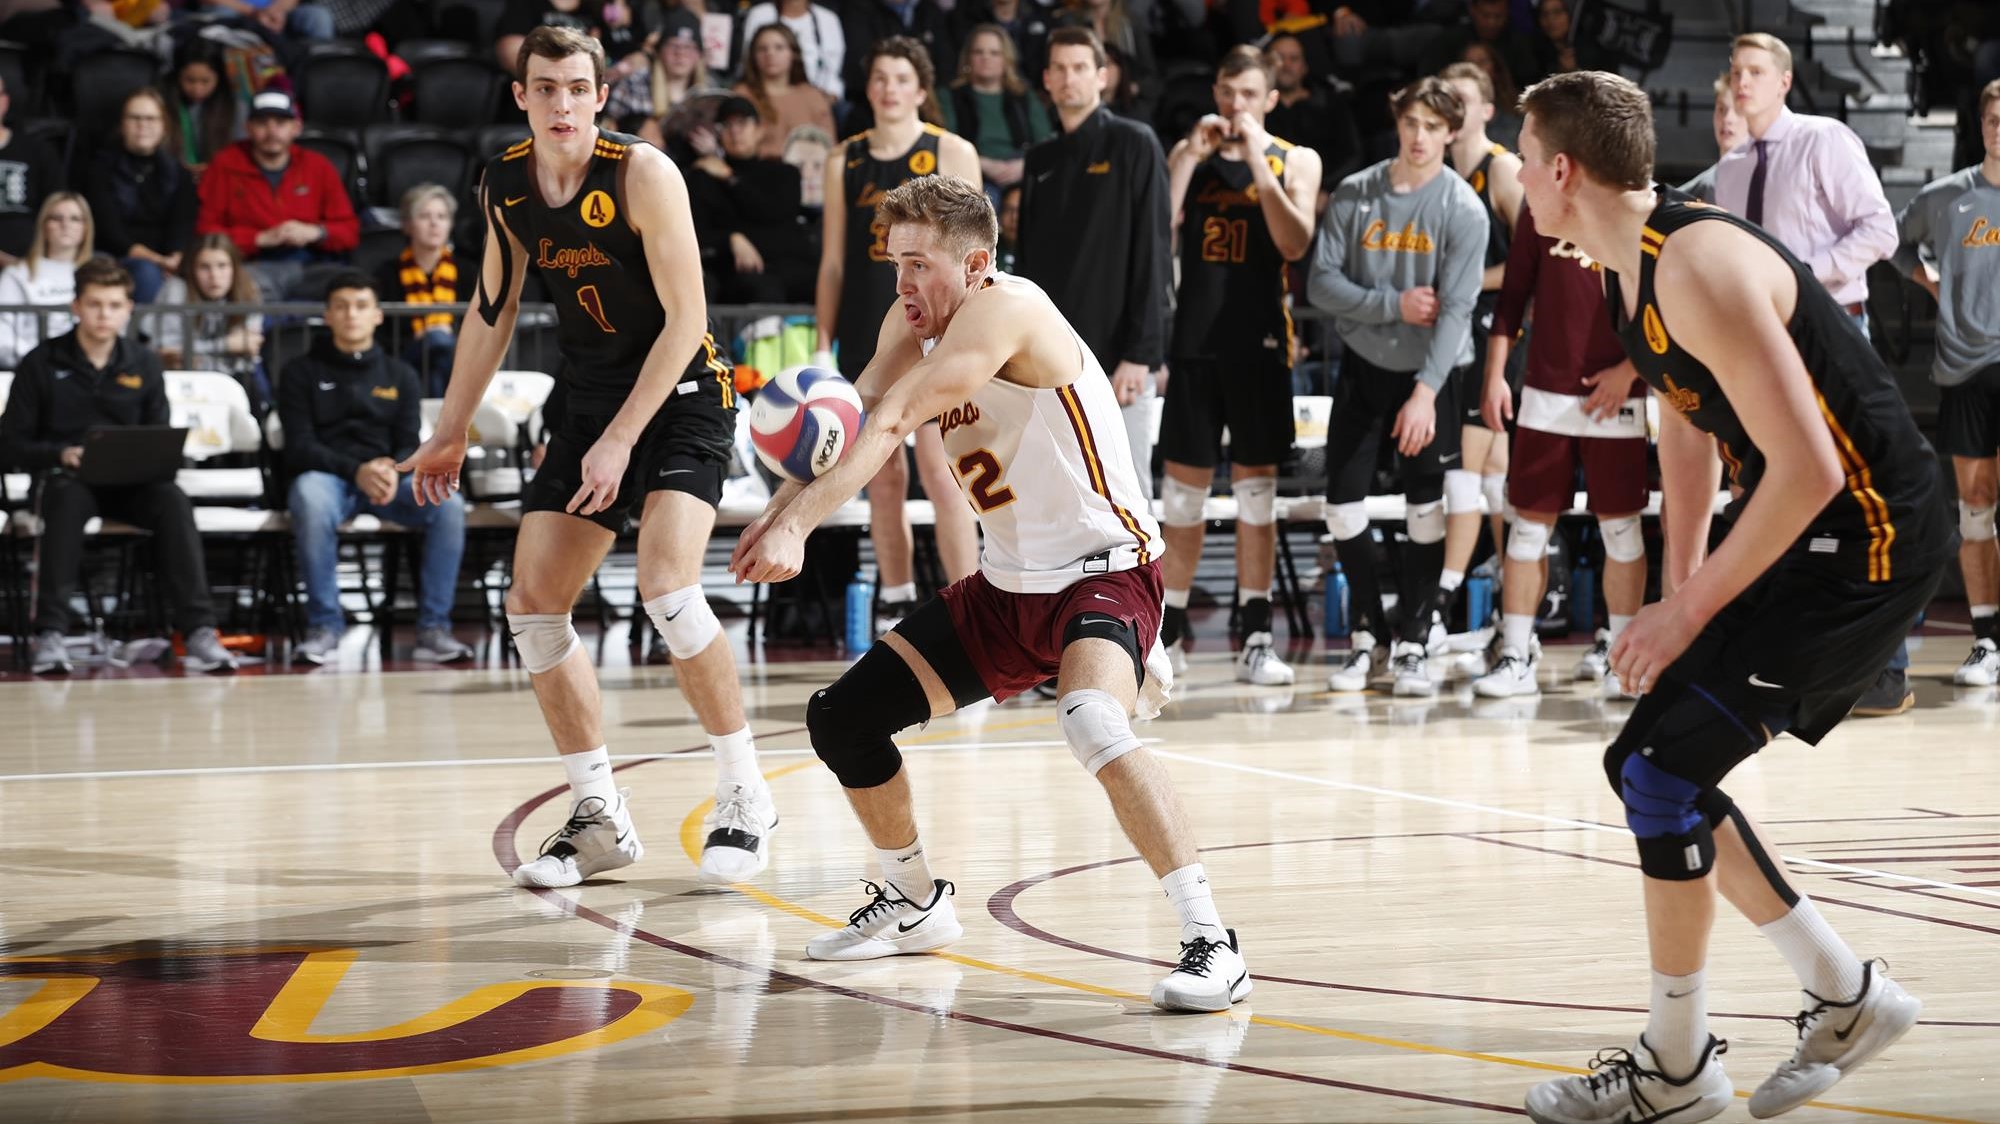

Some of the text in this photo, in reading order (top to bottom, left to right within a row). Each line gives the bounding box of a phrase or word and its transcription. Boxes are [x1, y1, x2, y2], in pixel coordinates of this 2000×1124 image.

[589, 194, 606, 223] 4
[1202, 216, 1247, 262] 21
[577, 285, 616, 333] 1
[816, 428, 839, 467] NCAA
[946, 447, 1018, 514] 2
